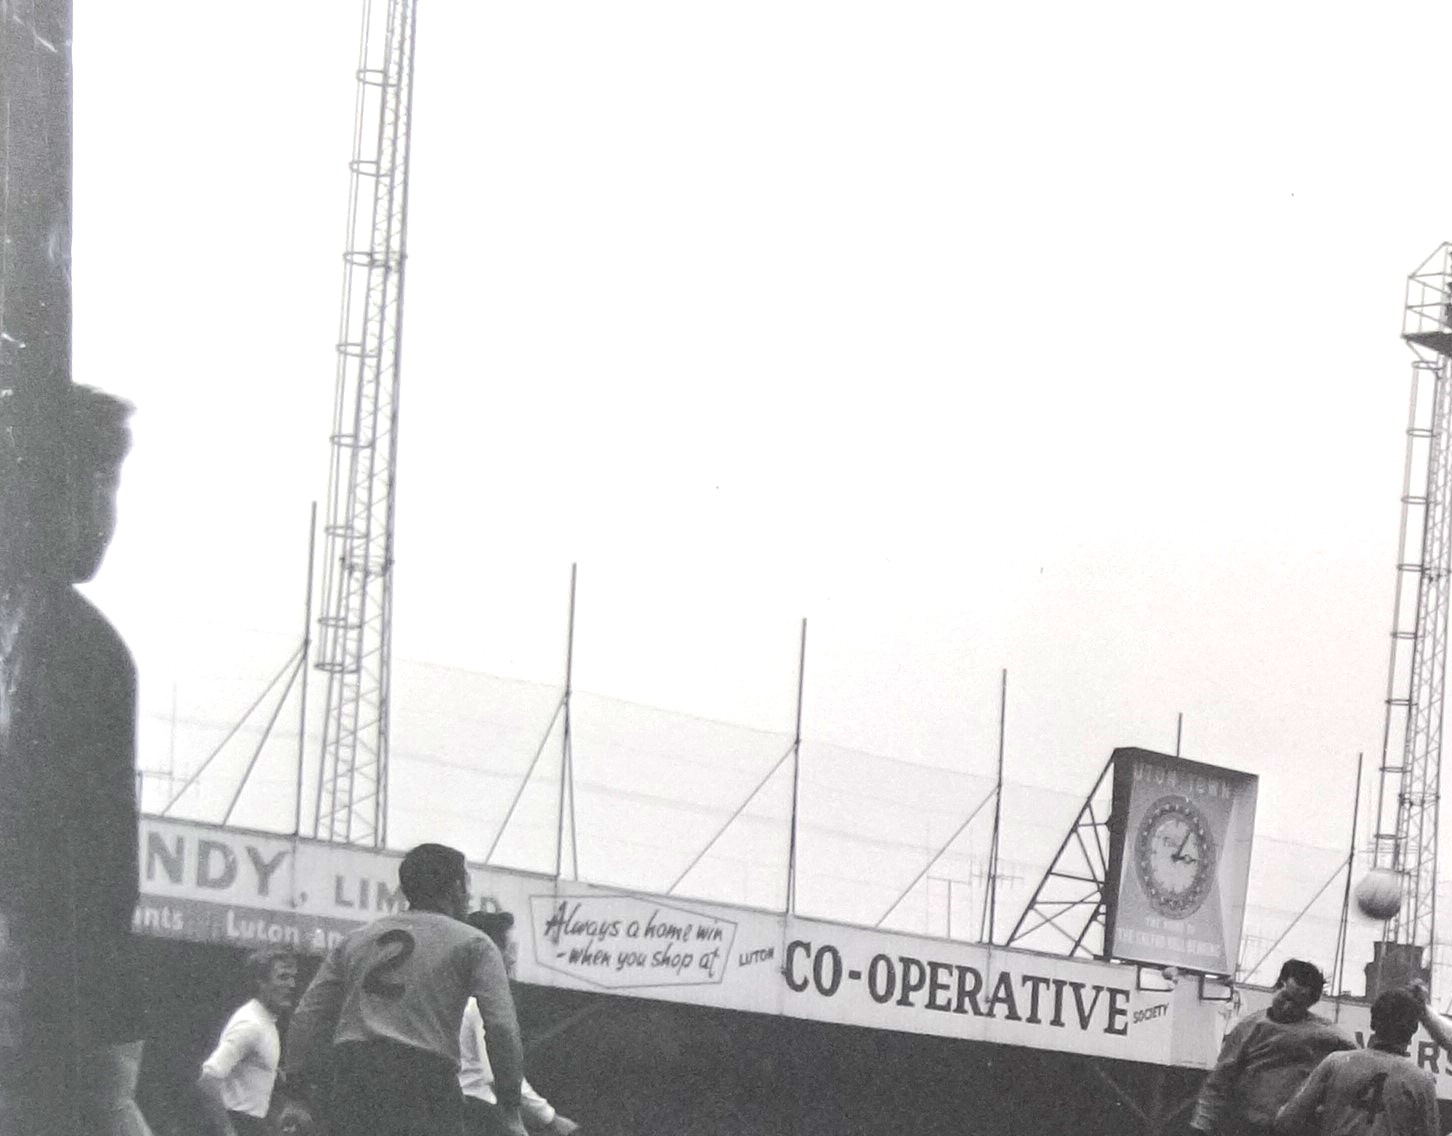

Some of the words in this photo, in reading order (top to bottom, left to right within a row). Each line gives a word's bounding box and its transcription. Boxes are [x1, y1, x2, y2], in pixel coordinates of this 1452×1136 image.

[226, 909, 299, 946] Luton
[544, 900, 619, 945] Always
[626, 919, 639, 937] a
[643, 908, 691, 942] home
[697, 926, 722, 942] win
[361, 928, 416, 1000] 2
[616, 949, 647, 971] you
[651, 941, 694, 976] shop
[699, 946, 721, 978] at
[739, 948, 775, 967] LUTON
[785, 940, 1129, 1036] CO-OPERATIVE
[1132, 1002, 1170, 1025] SOCIETY
[1356, 1071, 1388, 1124] 4
